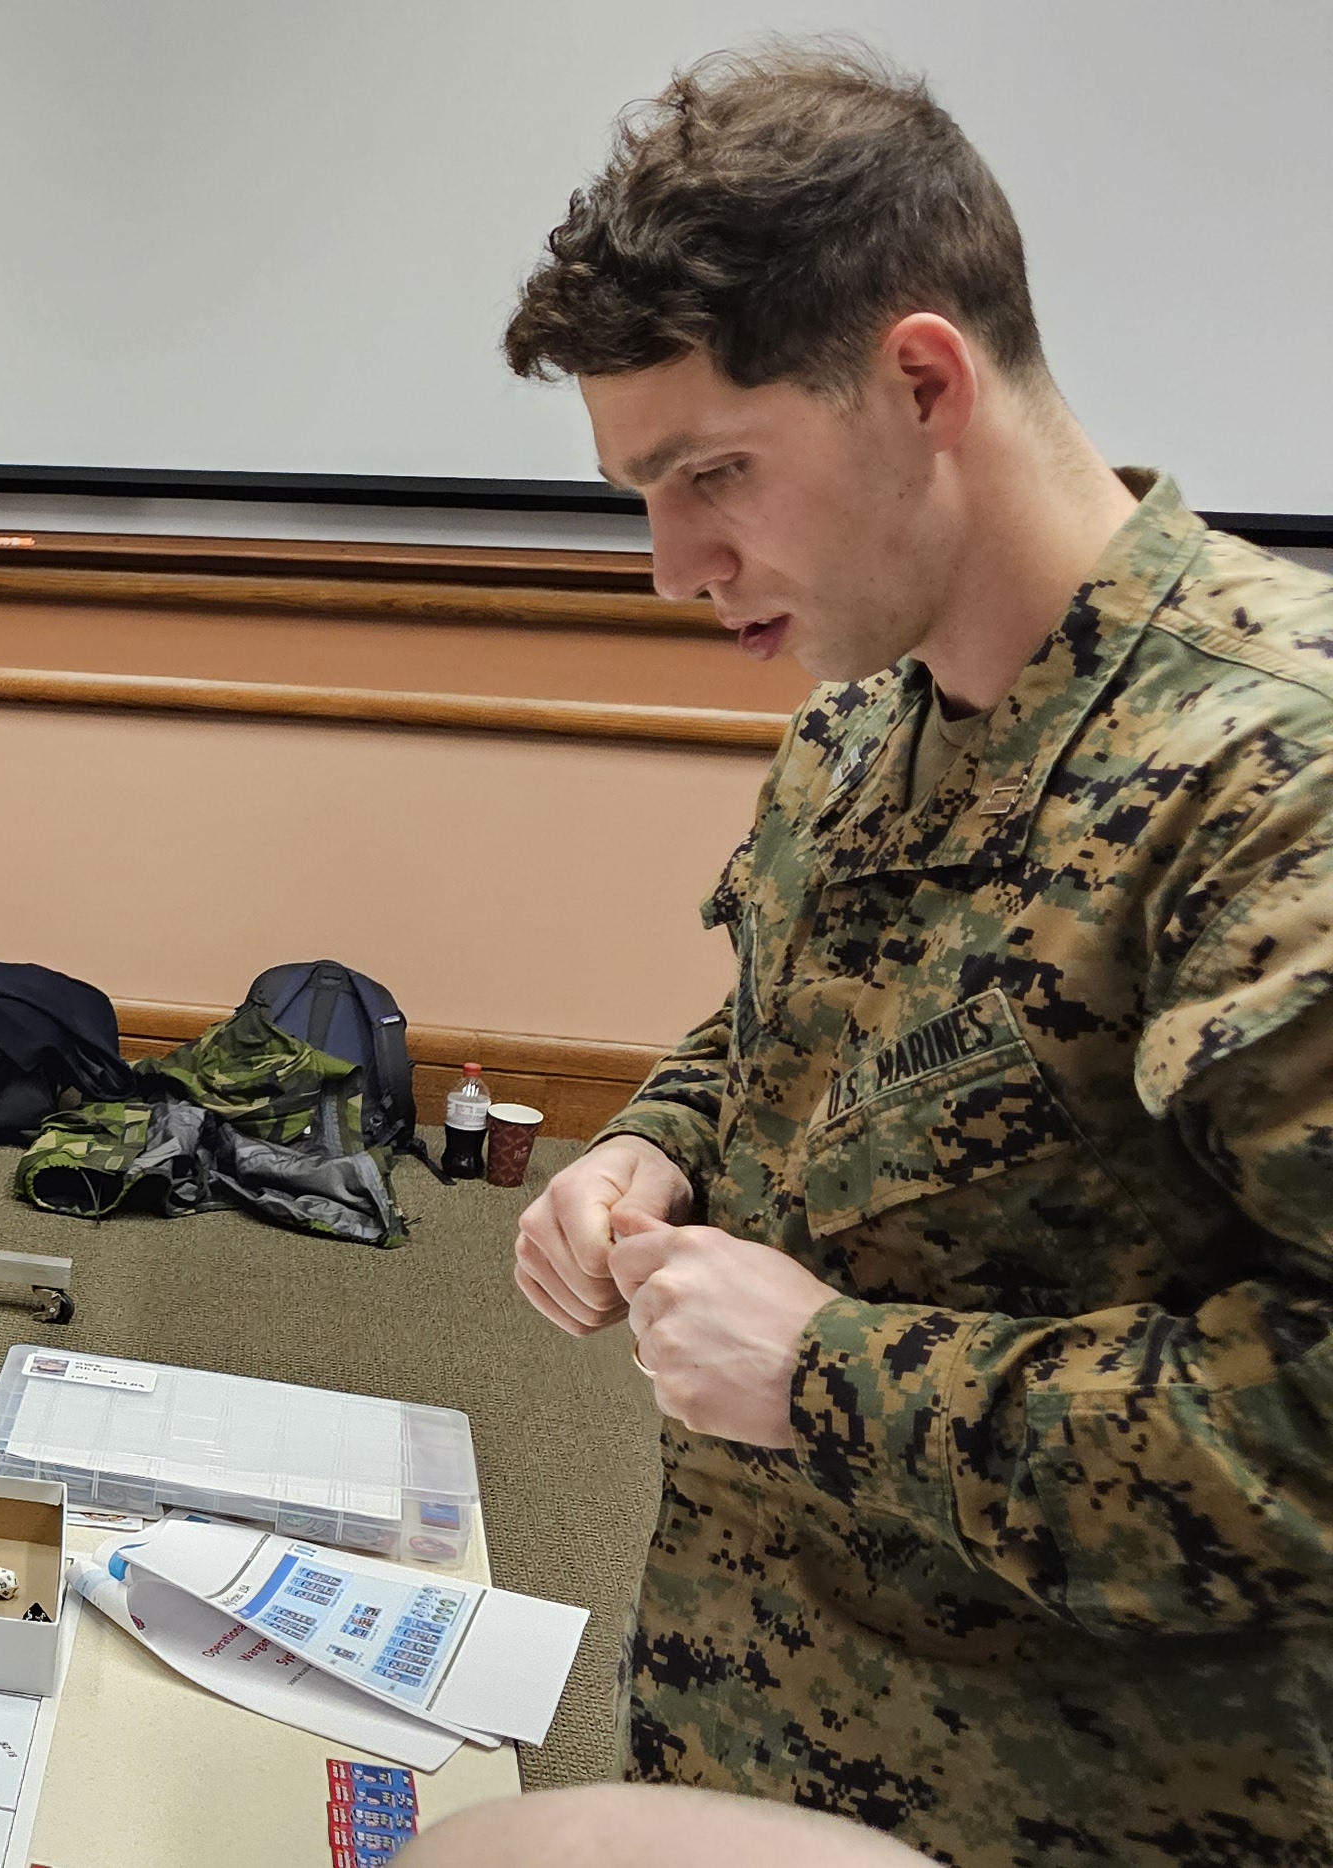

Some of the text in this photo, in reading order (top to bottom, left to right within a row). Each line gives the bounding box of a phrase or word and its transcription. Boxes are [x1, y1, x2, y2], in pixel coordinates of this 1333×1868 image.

[875, 1004, 993, 1090] MARINES
[201, 1622, 247, 1659] Operationa
[237, 1637, 272, 1663] Wargam
[275, 1651, 296, 1667] Sys
